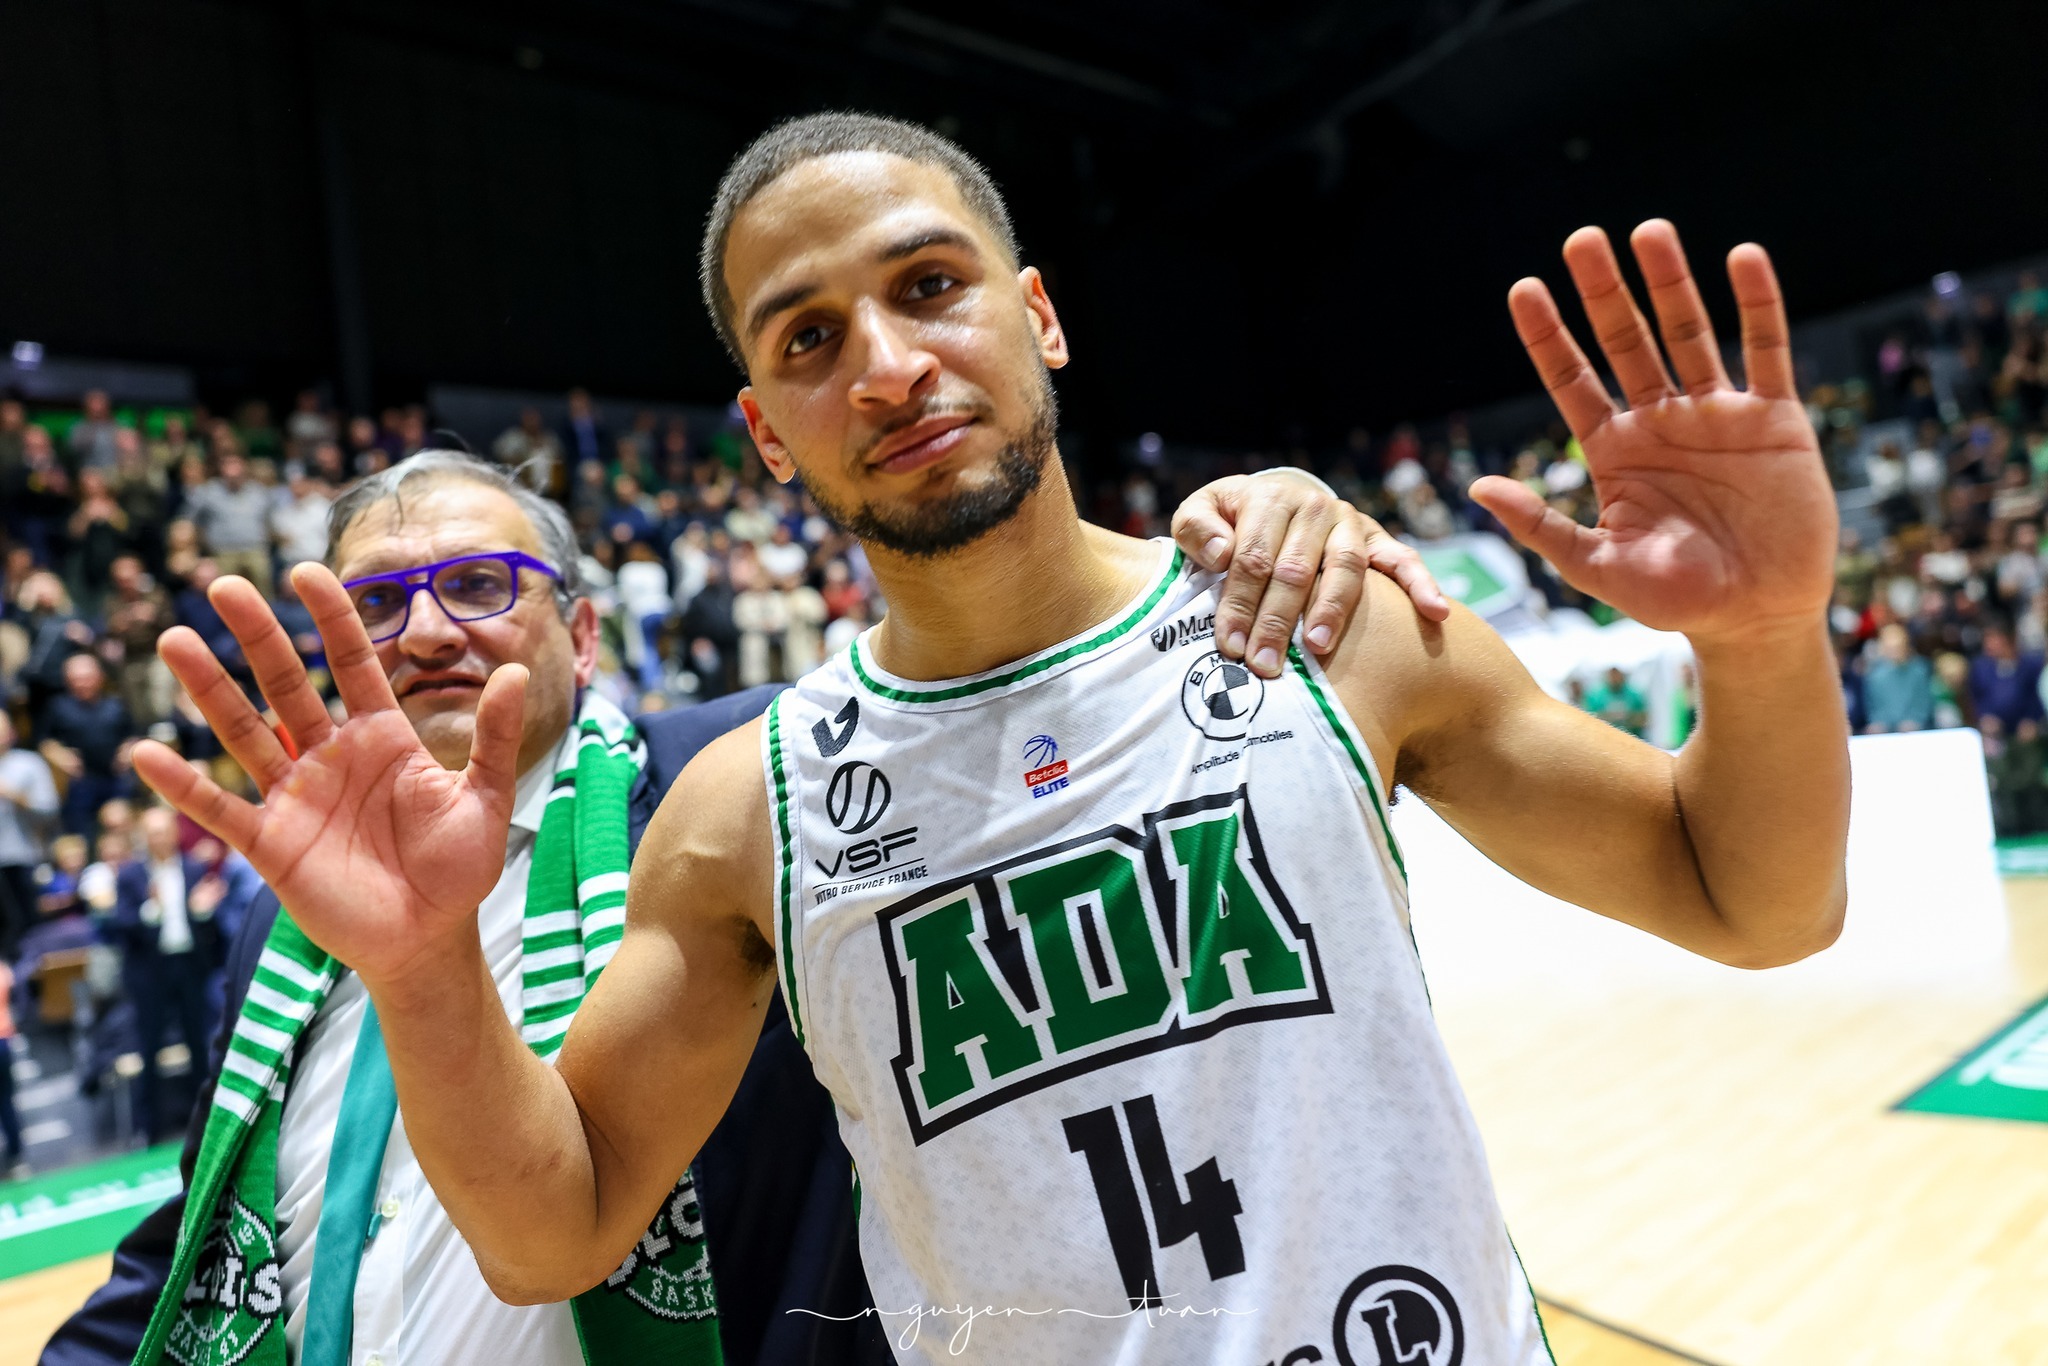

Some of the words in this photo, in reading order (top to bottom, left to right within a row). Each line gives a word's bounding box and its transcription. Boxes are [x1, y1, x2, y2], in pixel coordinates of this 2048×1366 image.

[1177, 613, 1216, 639] Mut
[1028, 764, 1066, 784] Betclic
[1190, 751, 1240, 776] Amplitude
[1032, 776, 1070, 799] ÉLITE
[815, 826, 919, 879] VSF
[814, 886, 838, 906] VITRO
[841, 877, 886, 895] SERVICE
[888, 865, 929, 885] FRANCE
[894, 801, 1314, 1122] ADA
[1062, 1094, 1247, 1312] 14
[650, 1277, 715, 1309] BASK
